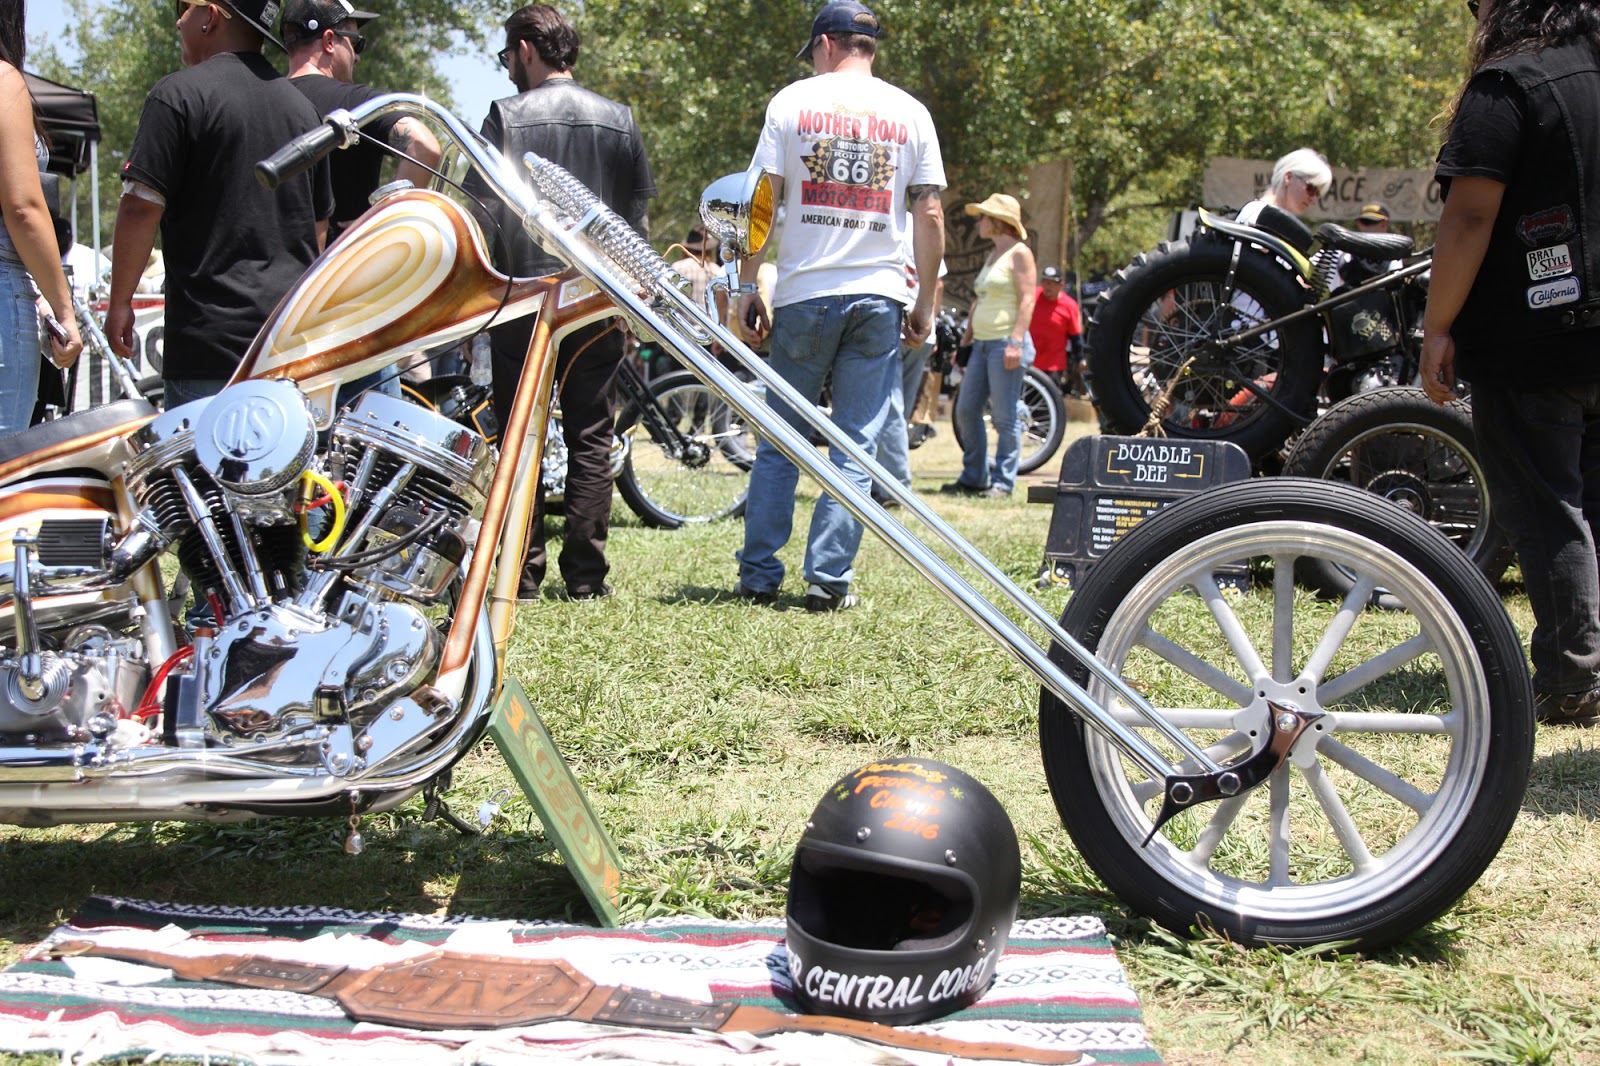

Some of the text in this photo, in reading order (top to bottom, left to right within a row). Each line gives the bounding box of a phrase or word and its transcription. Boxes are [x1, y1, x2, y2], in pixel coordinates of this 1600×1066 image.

[797, 109, 908, 145] MOTHER ROAD
[833, 151, 870, 161] ROUTE
[836, 140, 869, 152] HISTORIC
[832, 159, 869, 183] 66
[803, 188, 889, 211] MOTOR OIL
[801, 214, 887, 232] AMERICAN ROAD TRIP
[1528, 248, 1555, 275] BRAT
[1540, 254, 1569, 273] STYLE
[1530, 285, 1577, 306] California
[1116, 443, 1191, 464] BUMBLE
[1133, 464, 1167, 482] BEE
[883, 812, 940, 840] 2016
[805, 965, 923, 1010] CENTRAL
[928, 948, 996, 1002] COAST
